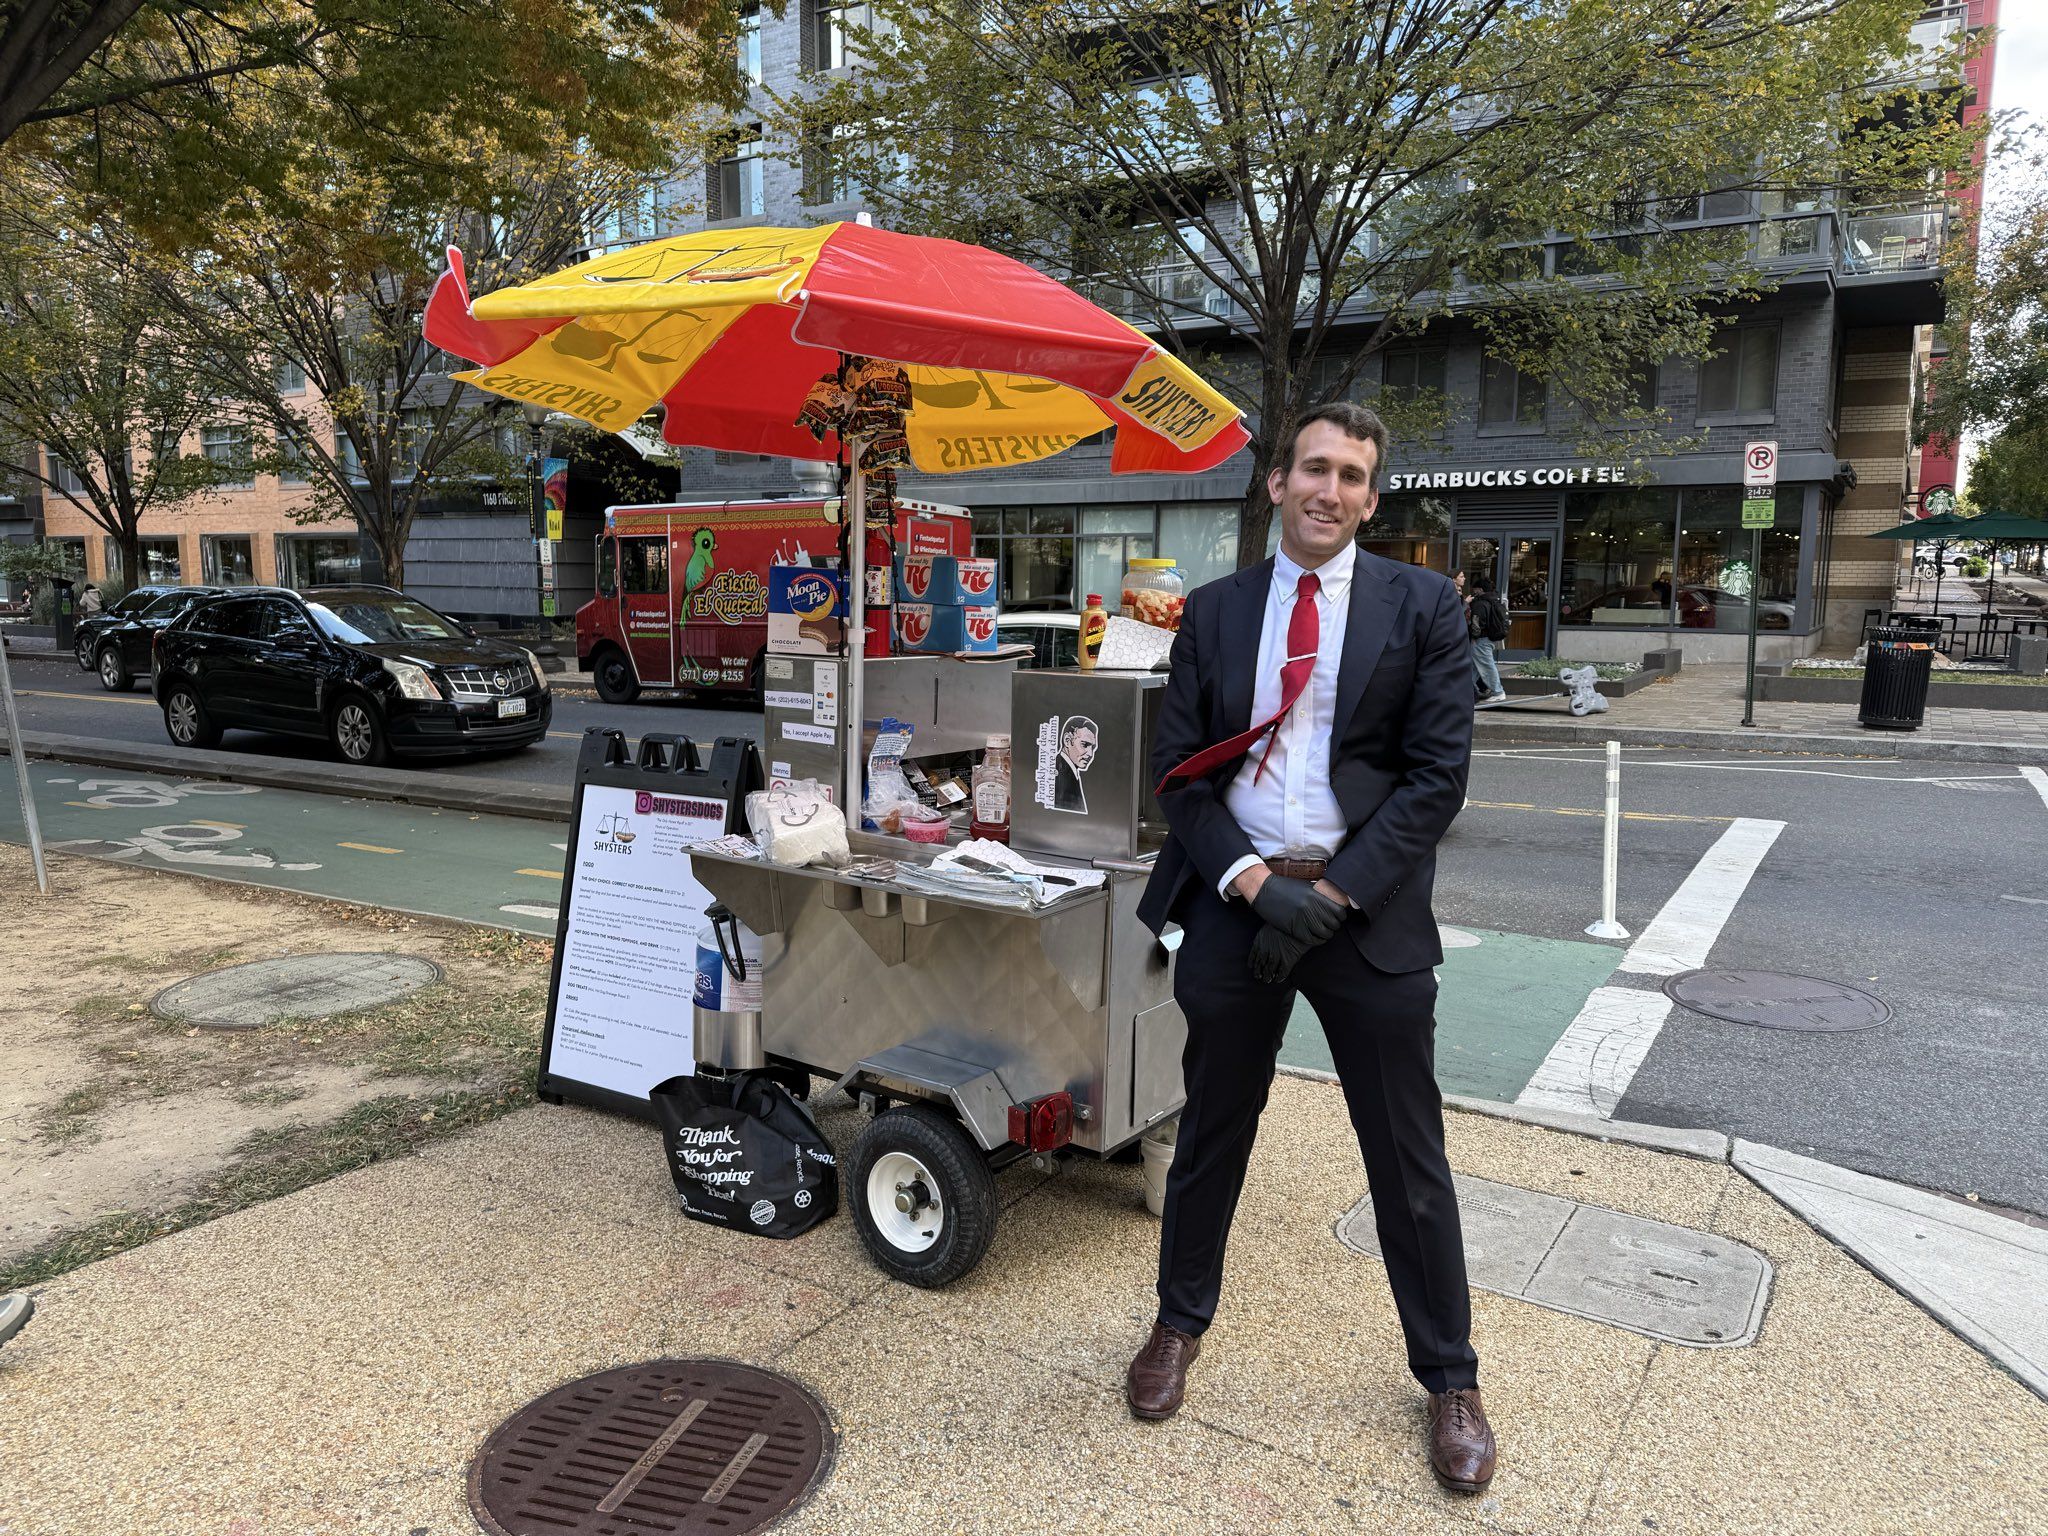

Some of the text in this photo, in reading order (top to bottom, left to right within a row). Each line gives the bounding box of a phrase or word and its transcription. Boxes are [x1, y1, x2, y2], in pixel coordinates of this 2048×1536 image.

[1122, 376, 1216, 438] SHYSTERS
[1390, 470, 1527, 490] STARBUCKS
[483, 492, 498, 506] 1160
[713, 568, 760, 595] Fiesta
[786, 582, 820, 600] Moon
[904, 565, 931, 596] RC
[959, 570, 993, 594] RC
[694, 587, 714, 616] El
[712, 587, 770, 626] Quetzal
[808, 591, 827, 606] Pie
[894, 612, 930, 642] RC
[966, 618, 994, 640] RC
[722, 657, 748, 666] We Cater
[680, 666, 744, 682] (571) 699 4255
[1048, 716, 1058, 746] damn.
[1036, 724, 1049, 800] Frankly my dear,
[1048, 756, 1058, 776] give
[1046, 778, 1055, 801] don't
[652, 797, 723, 820] SHYSTERSDOGS
[594, 841, 632, 856] SHYSTERS
[680, 1124, 740, 1146] Thank
[676, 1148, 742, 1166] You for
[678, 1164, 754, 1186] Shopping
[641, 1438, 671, 1468] PEPCO
[714, 1470, 735, 1494] MADE
[740, 1444, 757, 1462] USA
